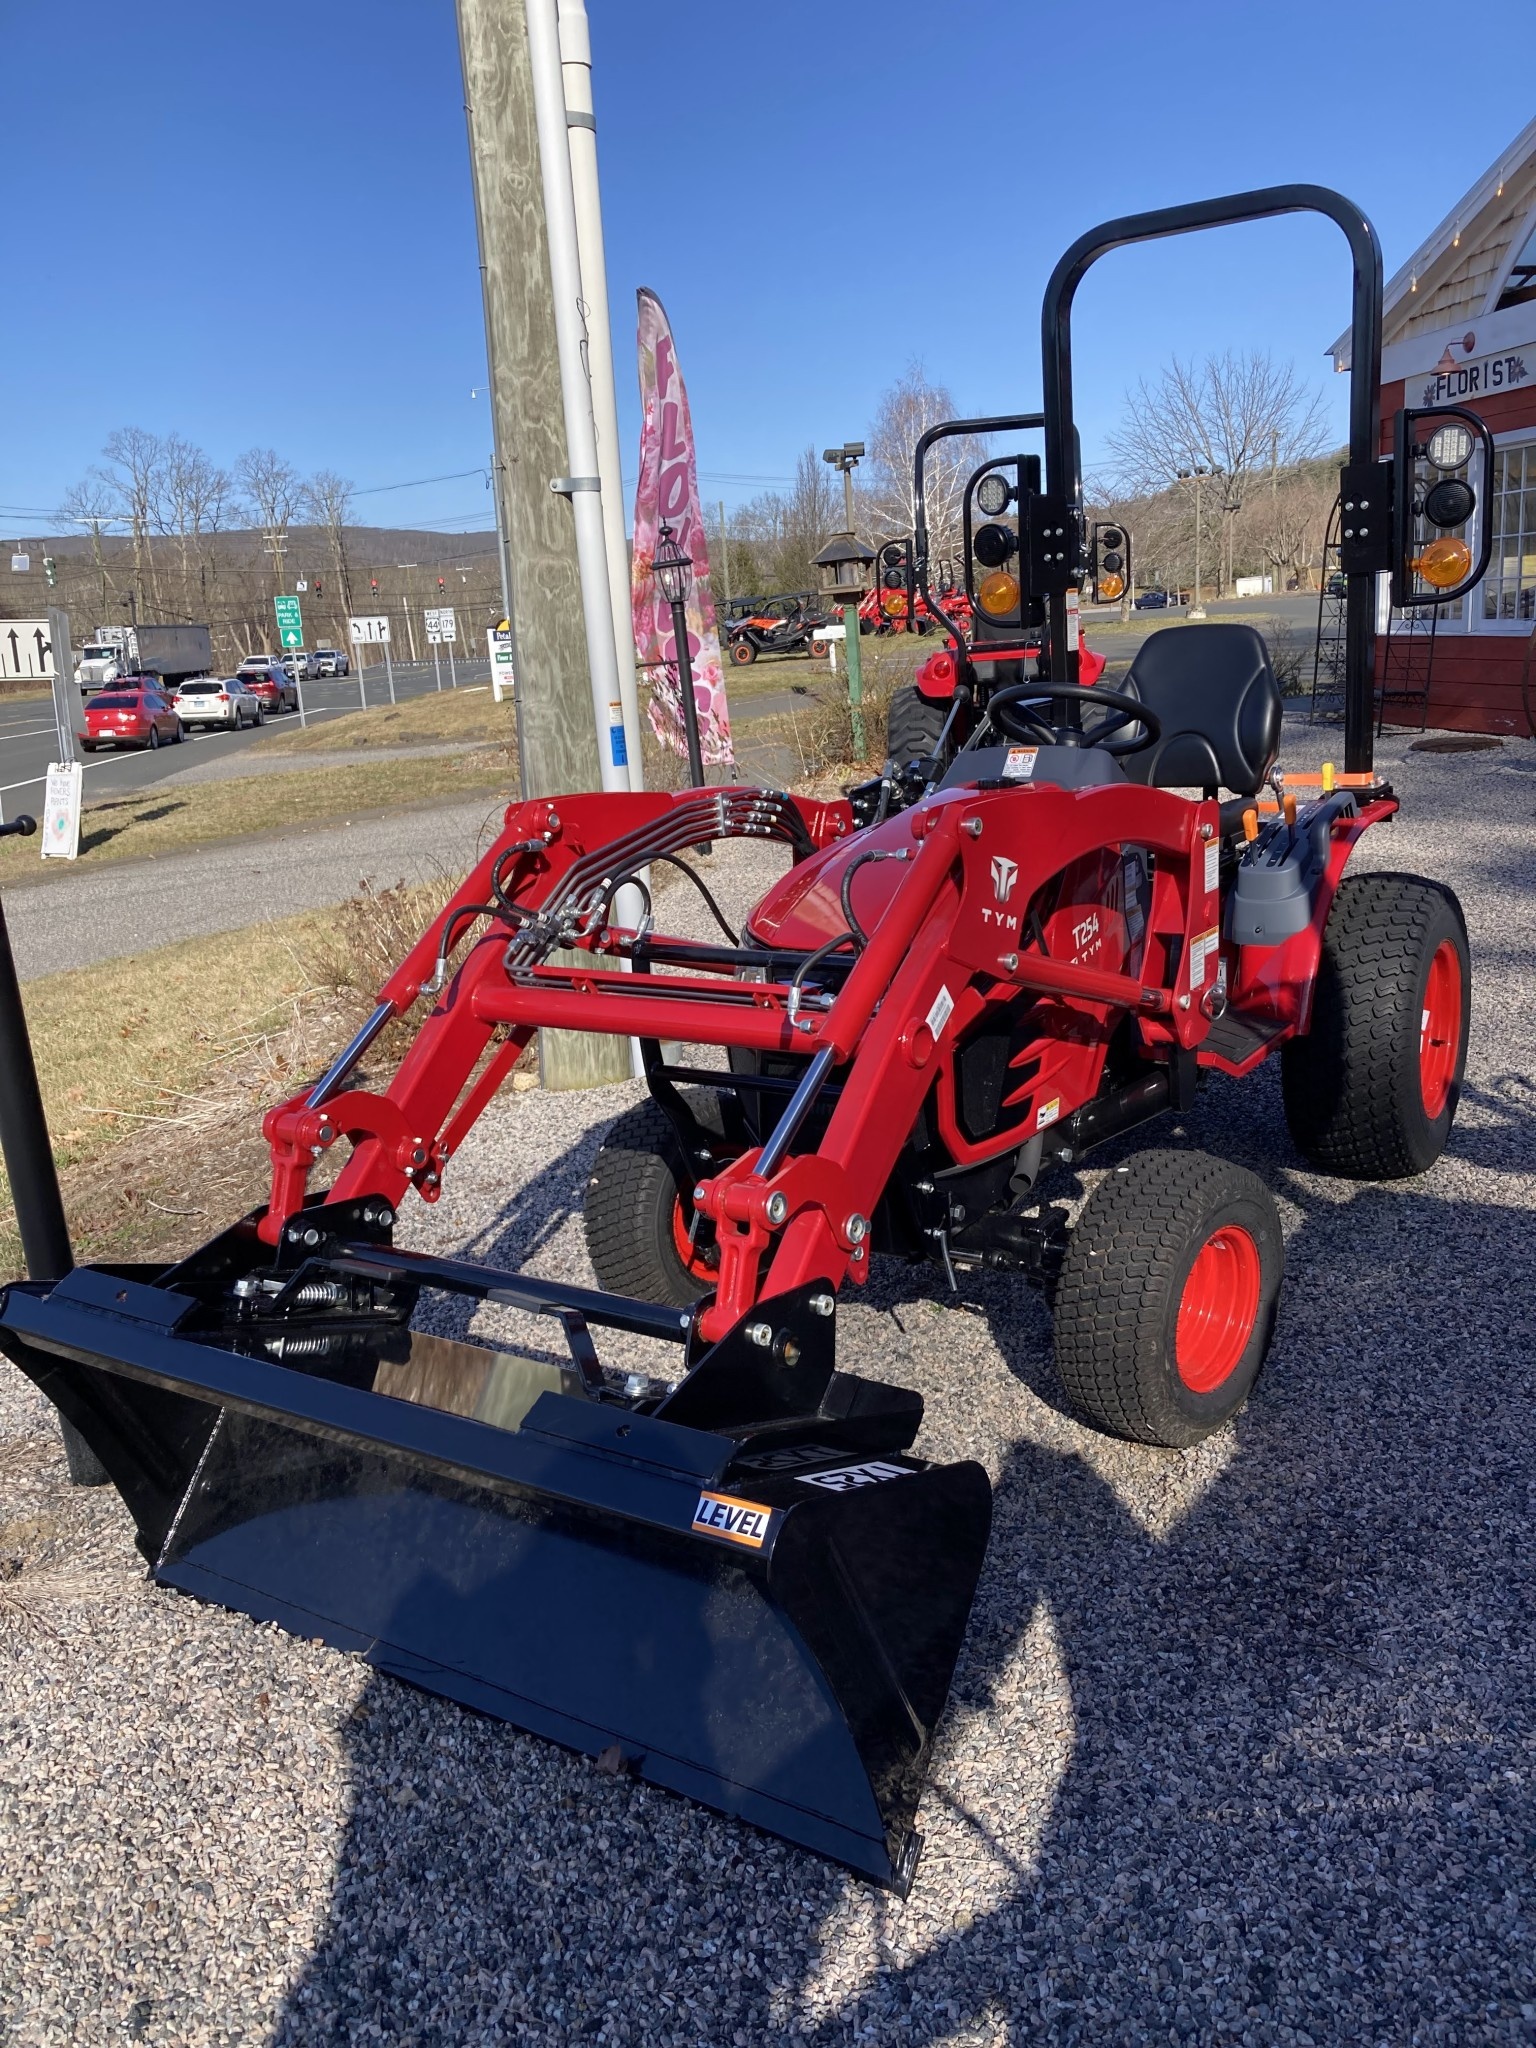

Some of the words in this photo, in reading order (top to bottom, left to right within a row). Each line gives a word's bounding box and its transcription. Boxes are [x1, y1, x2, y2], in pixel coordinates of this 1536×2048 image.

[1436, 356, 1515, 400] FLORIST
[656, 334, 713, 737] FLORS
[428, 620, 439, 629] 44
[442, 619, 454, 628] 179
[981, 908, 1017, 931] TYM
[1071, 912, 1100, 950] T254
[1081, 938, 1102, 963] TYM
[695, 1499, 764, 1539] LEVEL
